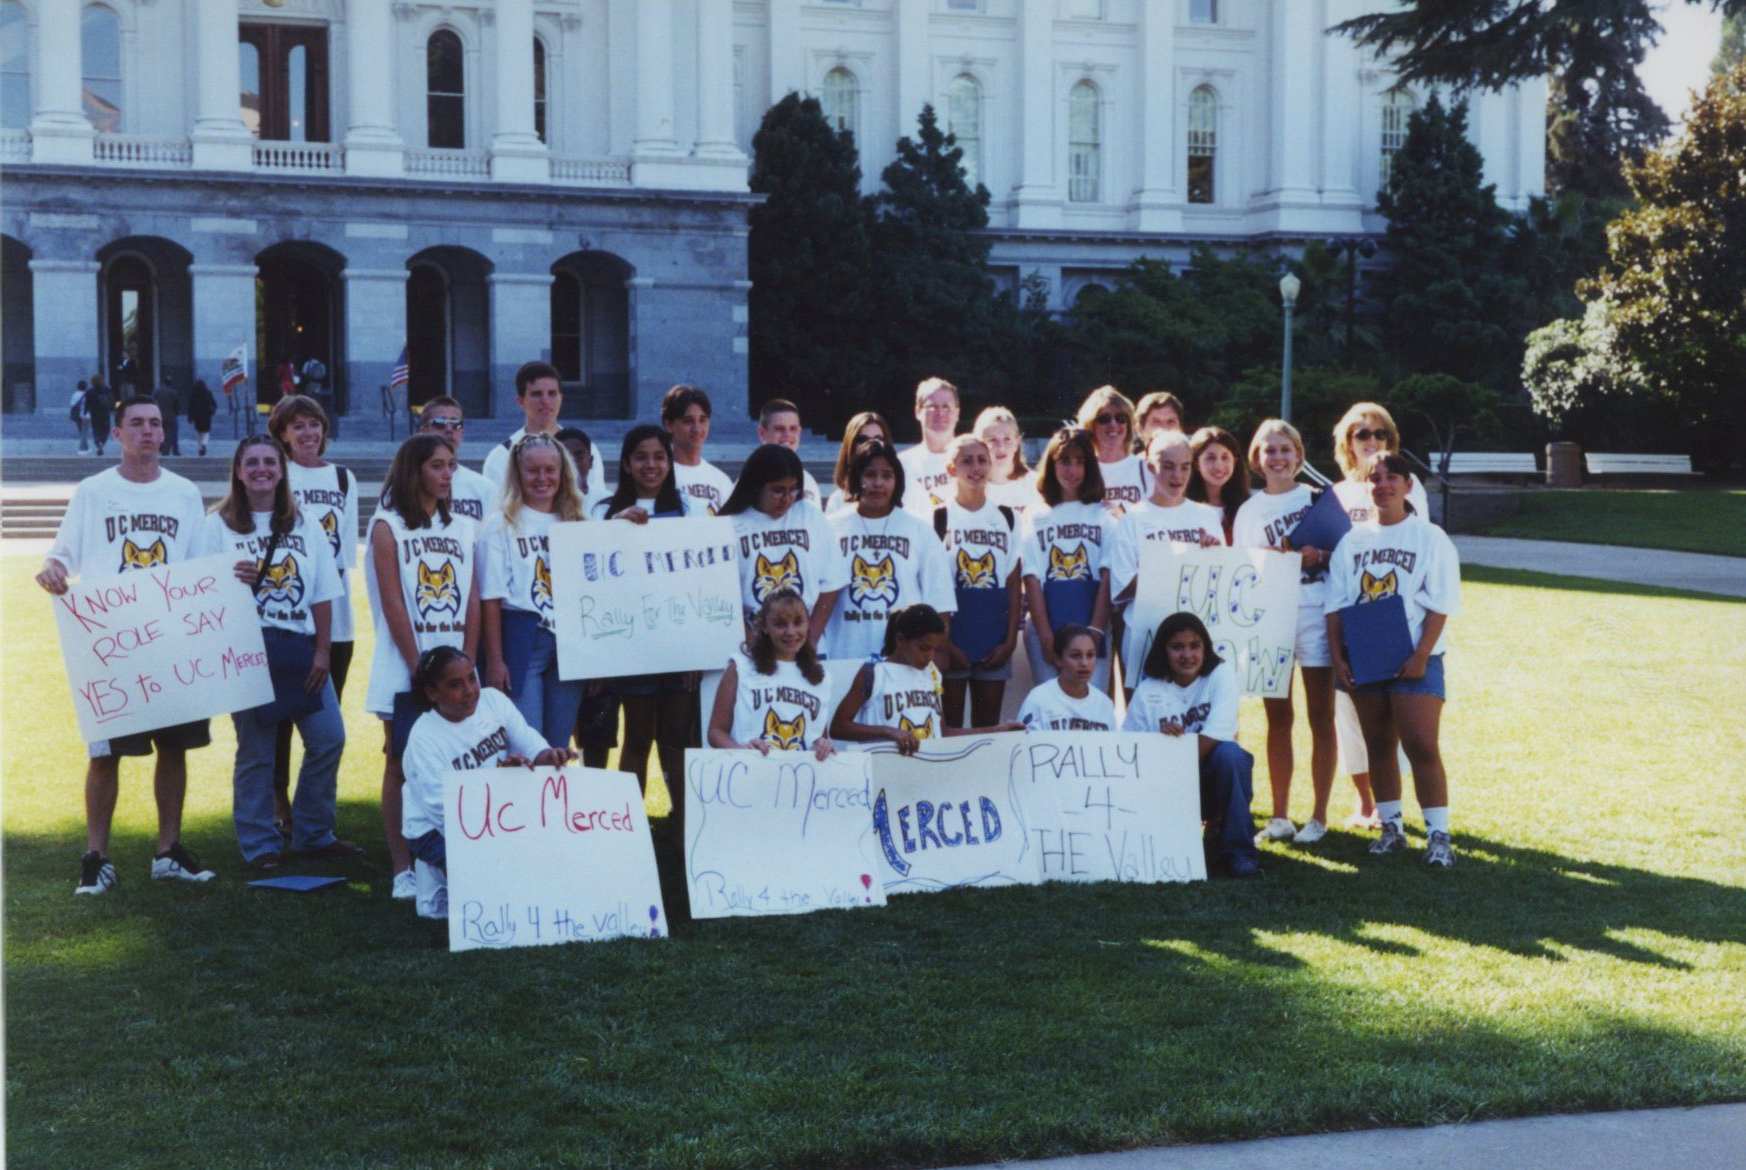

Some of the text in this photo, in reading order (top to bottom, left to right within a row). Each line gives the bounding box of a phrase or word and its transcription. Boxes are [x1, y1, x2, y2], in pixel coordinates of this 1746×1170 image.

[451, 499, 483, 521] RCED
[761, 529, 810, 552] MERCED
[861, 534, 910, 560] MERCED
[1056, 523, 1102, 546] MERCED
[644, 544, 736, 575] MERCED
[1371, 549, 1417, 574] MERCED
[61, 582, 138, 634] KNOW
[580, 595, 634, 639] Rally
[1177, 564, 1265, 627] UC
[92, 620, 165, 667] ROLE
[183, 606, 227, 637] SAY
[78, 677, 129, 718] YES
[174, 658, 215, 687] UC
[1029, 743, 1140, 783] RALLY
[541, 774, 634, 834] Merced
[700, 760, 872, 839] UC Merced
[1031, 828, 1194, 881] THE Valley
[758, 885, 771, 905] 4
[780, 887, 810, 905] the
[463, 901, 516, 945] Rally
[528, 906, 540, 938] 4
[553, 909, 587, 938] the
